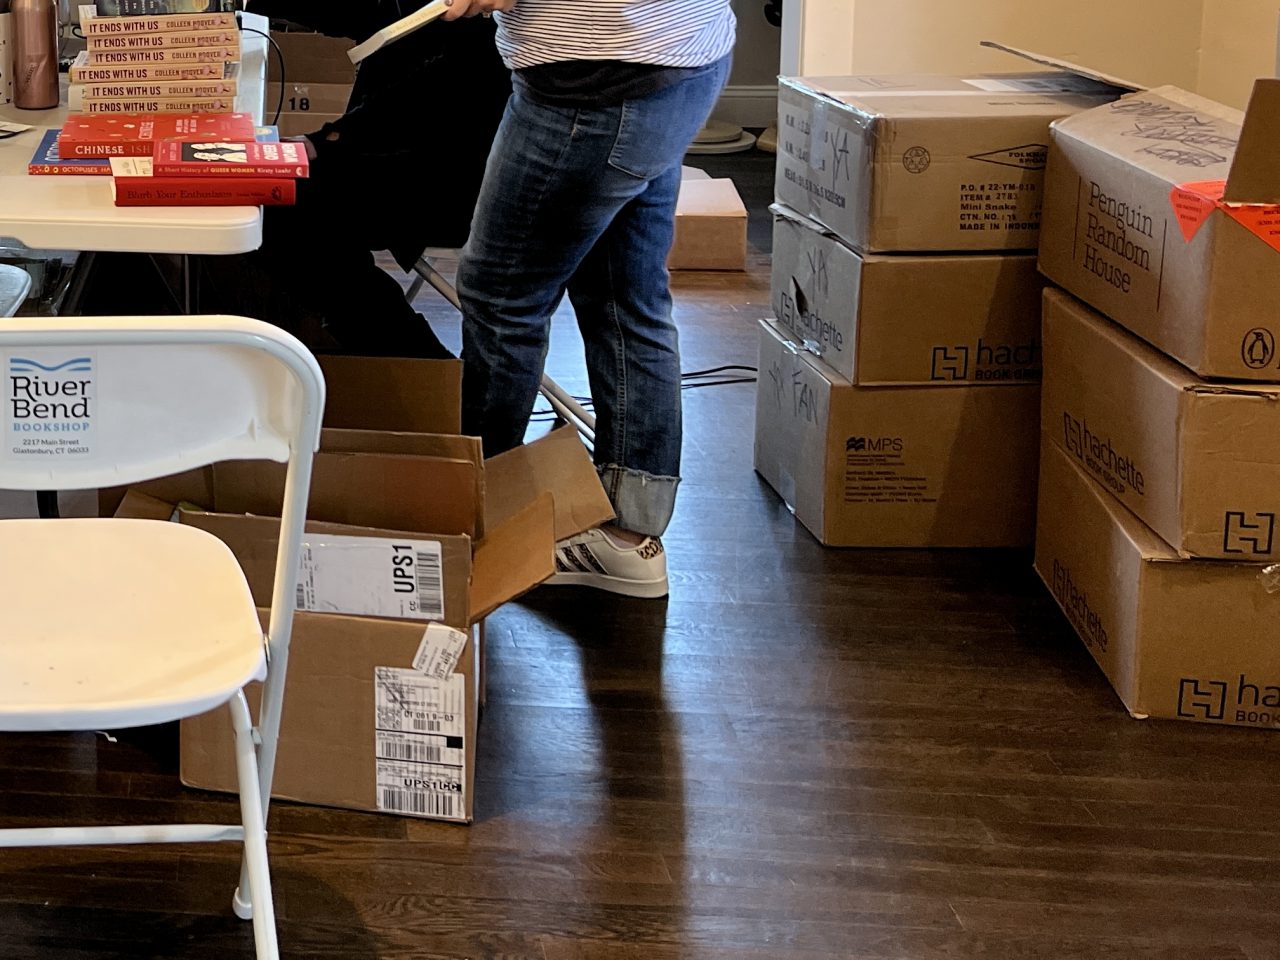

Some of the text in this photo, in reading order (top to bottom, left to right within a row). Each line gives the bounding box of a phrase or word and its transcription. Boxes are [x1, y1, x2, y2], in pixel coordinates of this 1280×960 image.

[90, 24, 97, 33] IT
[100, 23, 121, 32] ENDS
[123, 22, 145, 32] WITH
[148, 21, 159, 30] US
[94, 40, 101, 48] IT
[104, 39, 126, 48] ENDS
[128, 38, 150, 47] WITH
[153, 37, 163, 46] US
[96, 54, 103, 63] IT
[106, 53, 127, 62] ENDS
[130, 53, 151, 61] WITH
[154, 52, 164, 61] US
[79, 71, 86, 80] IT
[89, 70, 111, 79] ENDS
[113, 70, 135, 79] WITH
[137, 69, 147, 78] US
[93, 88, 100, 96] IT
[103, 87, 125, 96] ENDS
[127, 87, 148, 95] WITH
[150, 87, 161, 95] US
[90, 103, 97, 112] IT
[100, 103, 121, 112] ENDS
[124, 103, 145, 111] WITH
[147, 103, 158, 111] US
[289, 97, 310, 111] 18
[75, 145, 124, 155] CHINESE
[127, 191, 153, 199] Blurb
[156, 191, 176, 199] Your
[180, 191, 232, 199] Enthusiasm
[1089, 181, 1153, 238] Penguin
[1087, 213, 1150, 271] Random
[1083, 244, 1131, 293] House
[797, 302, 843, 352] achette
[10, 376, 91, 402] River
[11, 397, 91, 419] Bend
[14, 423, 90, 432] BOOKSHOP
[868, 438, 903, 452] MPS
[1084, 418, 1145, 496] hachette
[392, 545, 415, 594] UPS1
[1236, 711, 1280, 725] BOOK
